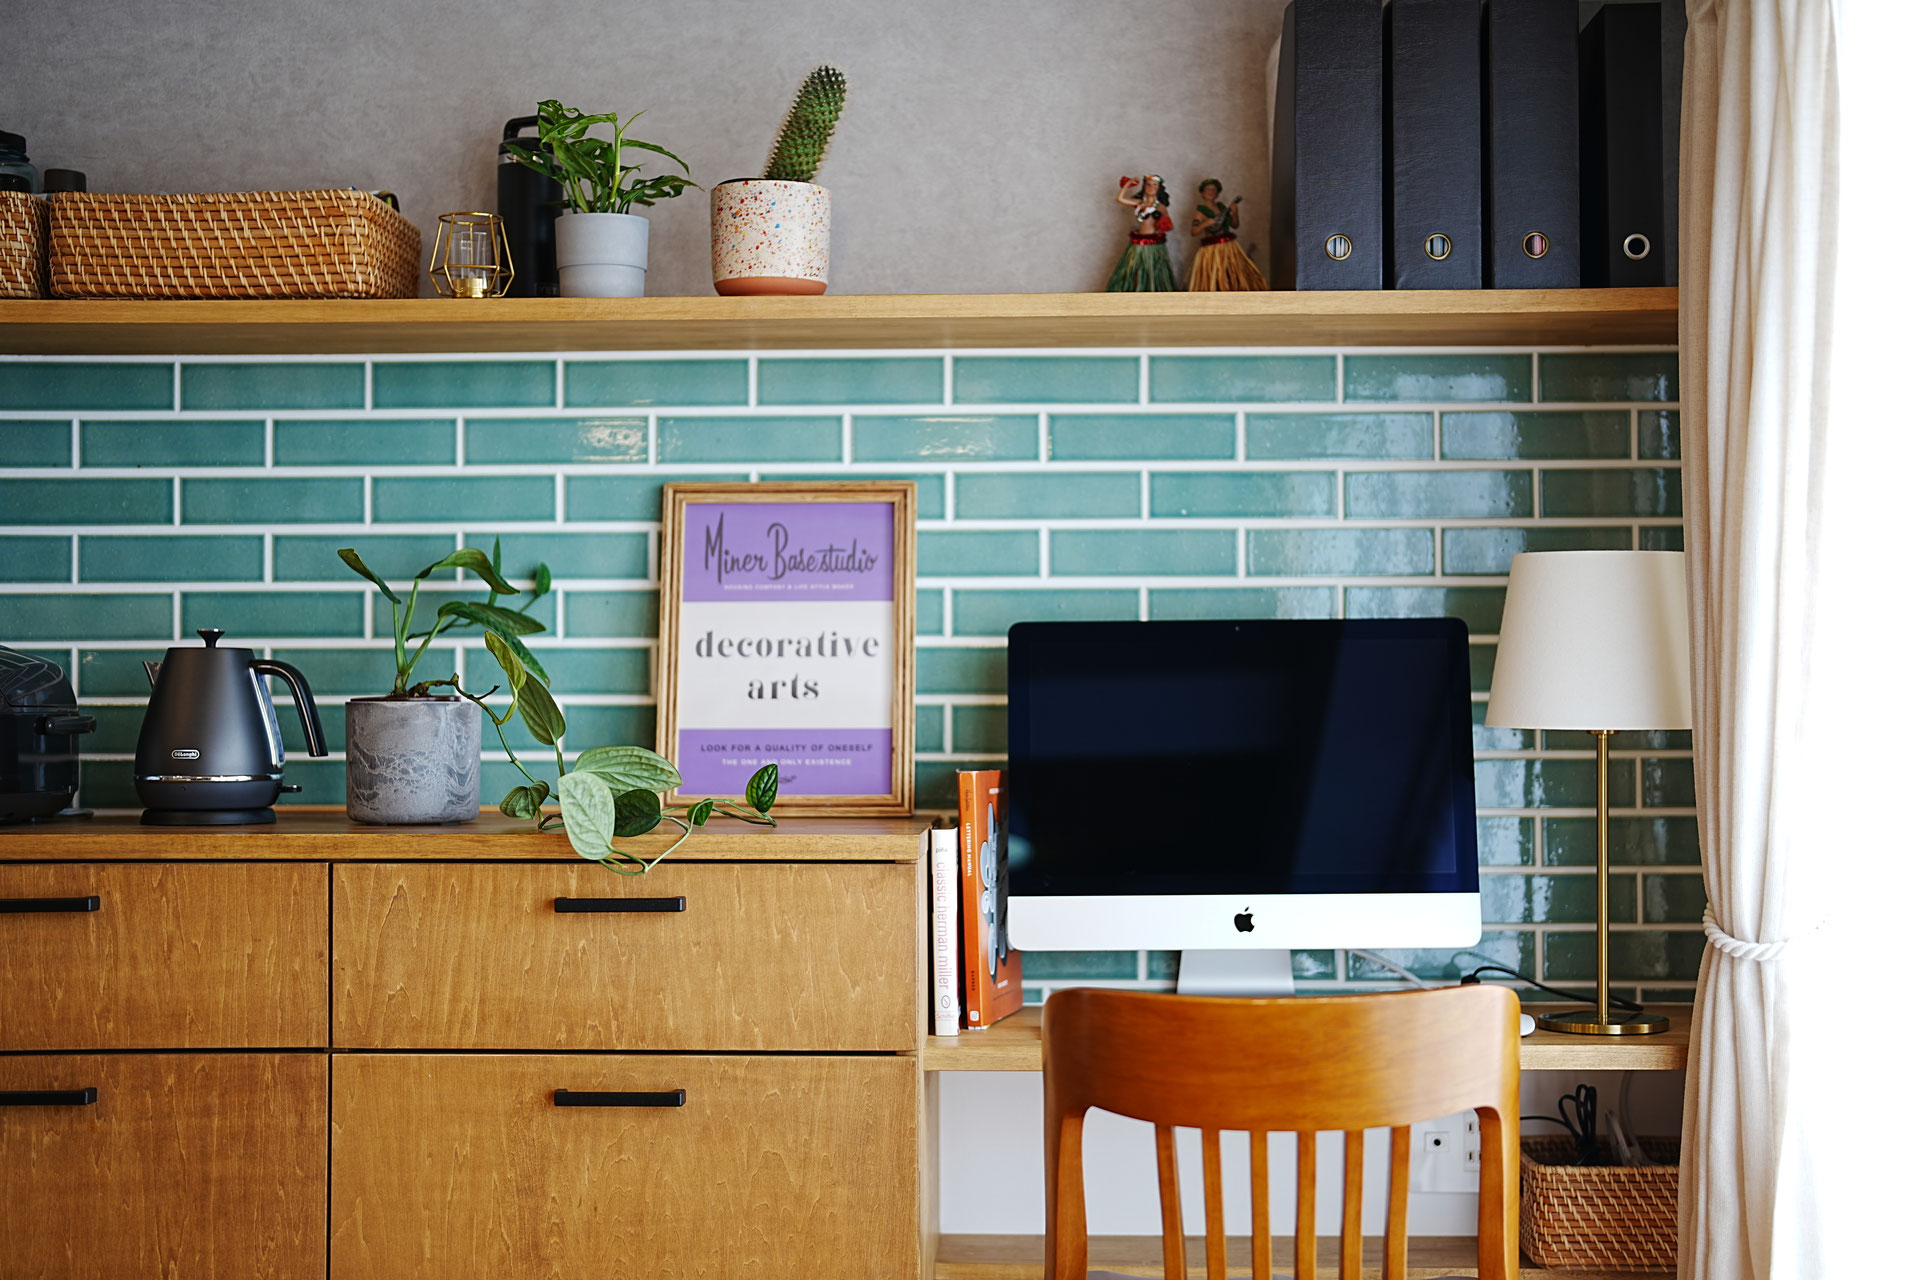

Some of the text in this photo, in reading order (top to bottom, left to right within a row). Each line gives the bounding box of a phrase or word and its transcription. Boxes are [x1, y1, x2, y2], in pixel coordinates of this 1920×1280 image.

[704, 511, 768, 585] Miner
[794, 583, 808, 591] LIFE
[809, 583, 830, 591] STYLE
[695, 630, 880, 658] decorative
[747, 673, 819, 700] arts
[700, 744, 874, 752] LOOK FOR A QUALITY OF ONESELF
[722, 758, 852, 766] THE ONE AND ONLY EXISTENCE
[965, 822, 973, 854] LETTERING
[936, 862, 952, 990] classic herman miller
